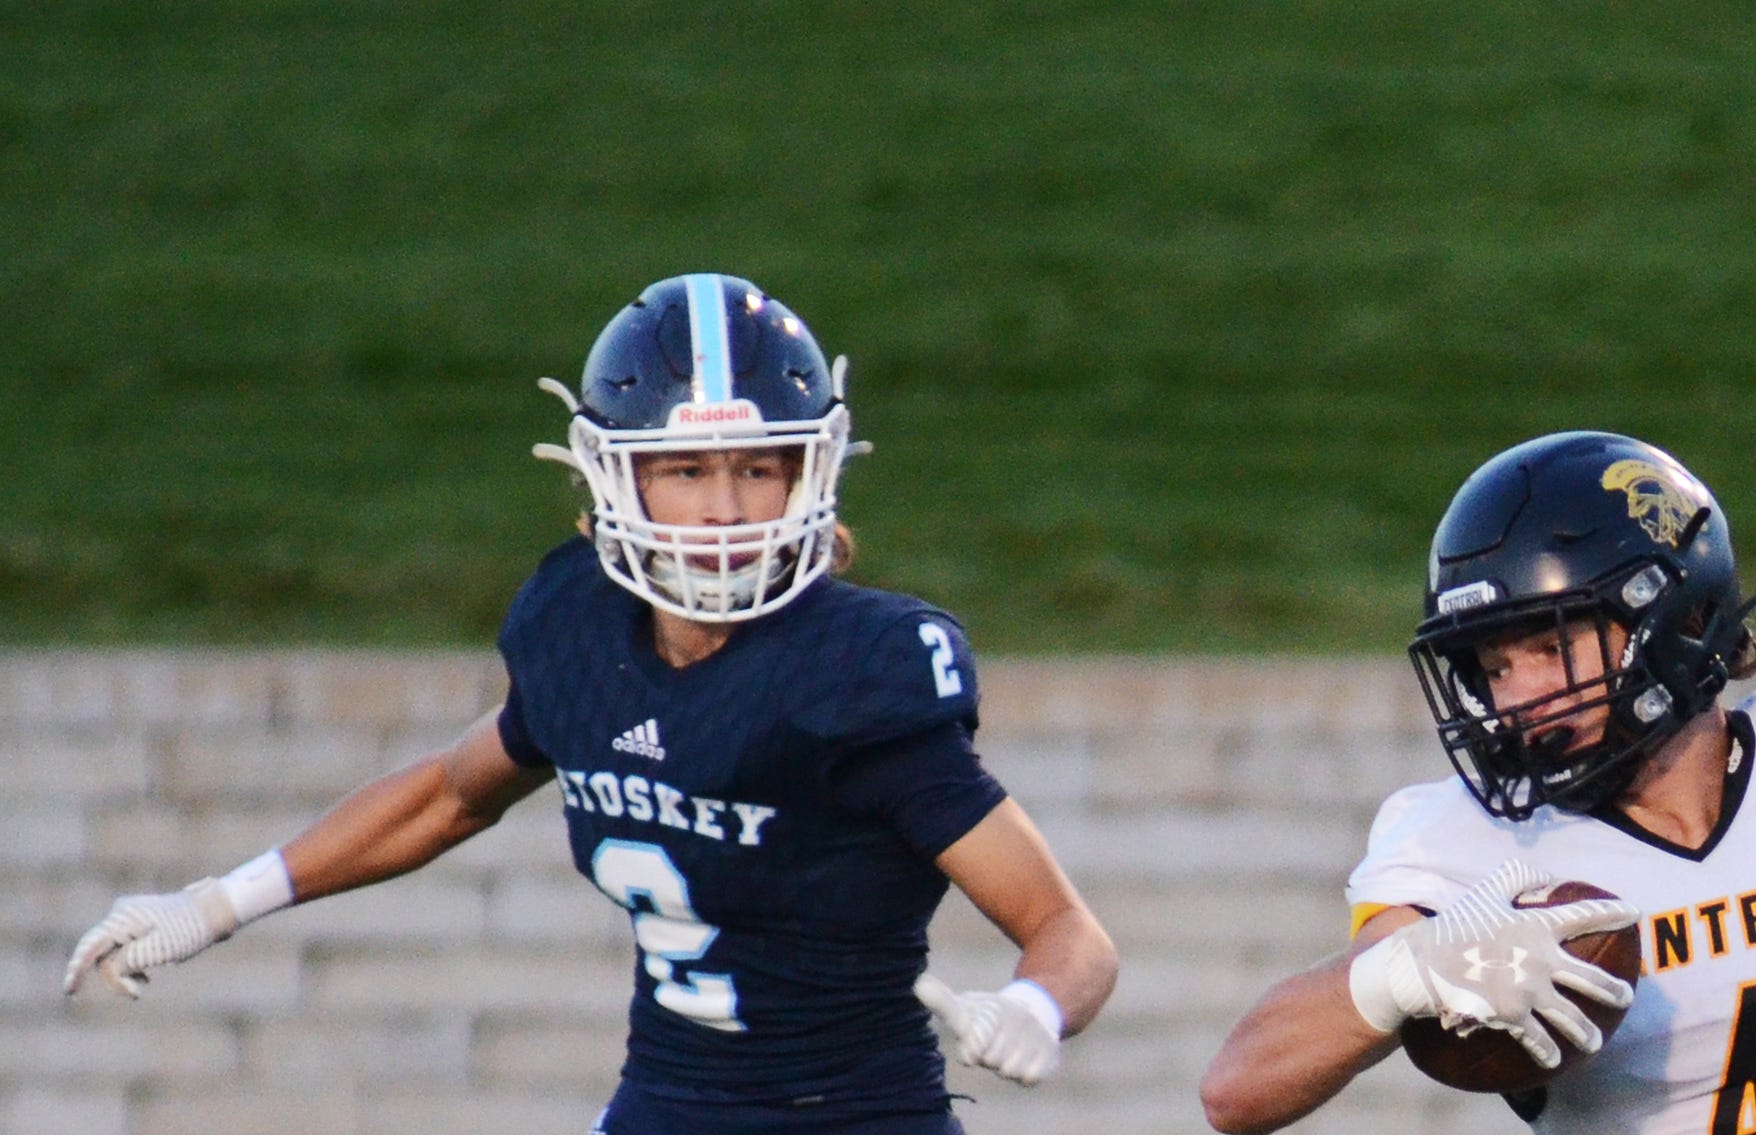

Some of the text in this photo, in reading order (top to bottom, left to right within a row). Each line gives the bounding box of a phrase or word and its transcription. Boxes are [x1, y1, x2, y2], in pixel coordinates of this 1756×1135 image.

[679, 406, 750, 422] Riddell
[918, 622, 962, 698] 2
[592, 837, 748, 1032] 2
